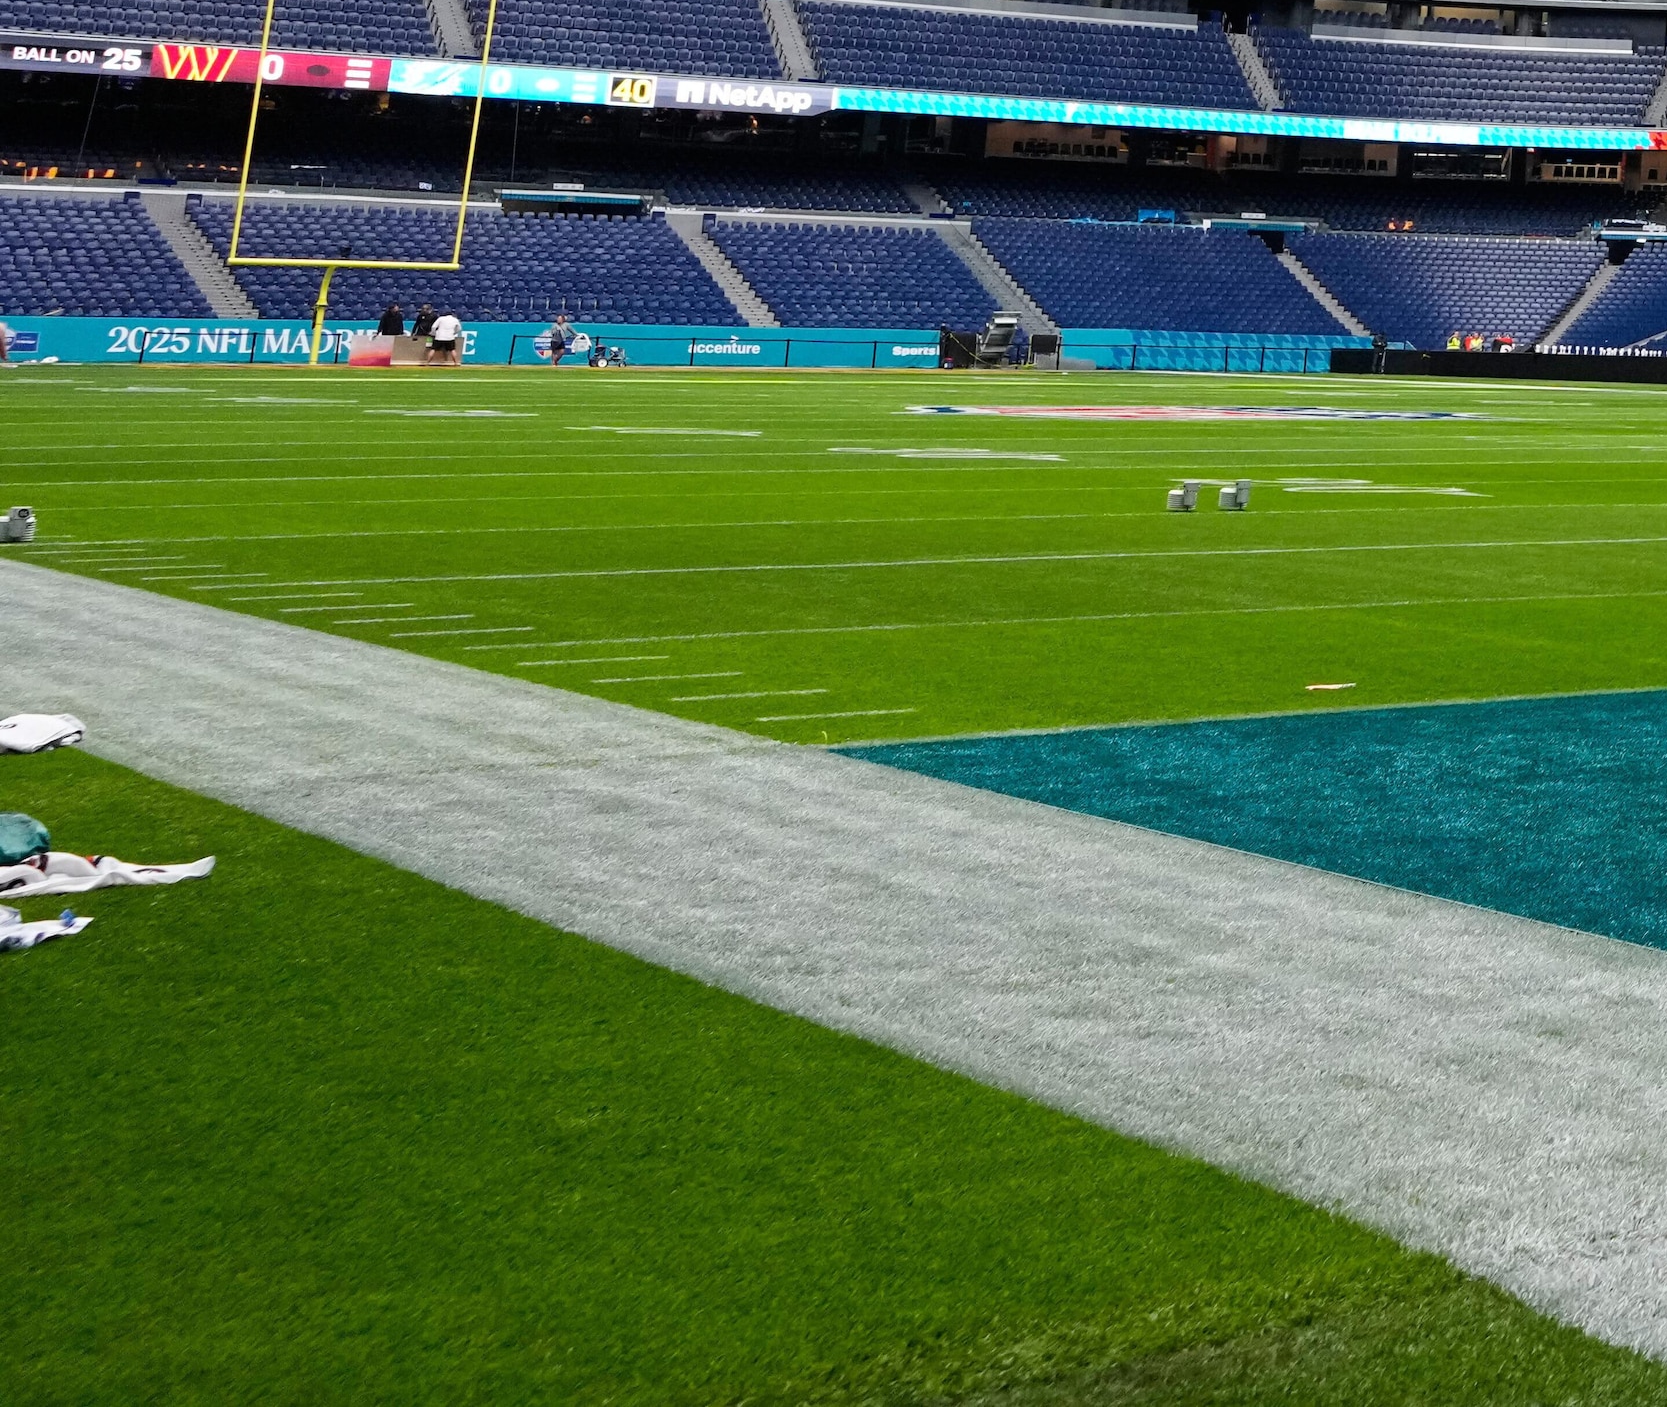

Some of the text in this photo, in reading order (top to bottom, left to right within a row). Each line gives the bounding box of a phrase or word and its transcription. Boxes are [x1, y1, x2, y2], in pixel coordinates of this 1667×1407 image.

[12, 46, 142, 71] BALL ON 25
[262, 54, 284, 81] 0
[612, 78, 651, 104] 40
[707, 83, 812, 113] NetApp
[107, 326, 195, 354] 2025
[199, 327, 256, 354] NFL
[688, 340, 760, 355] accenture
[892, 345, 936, 356] Sports
